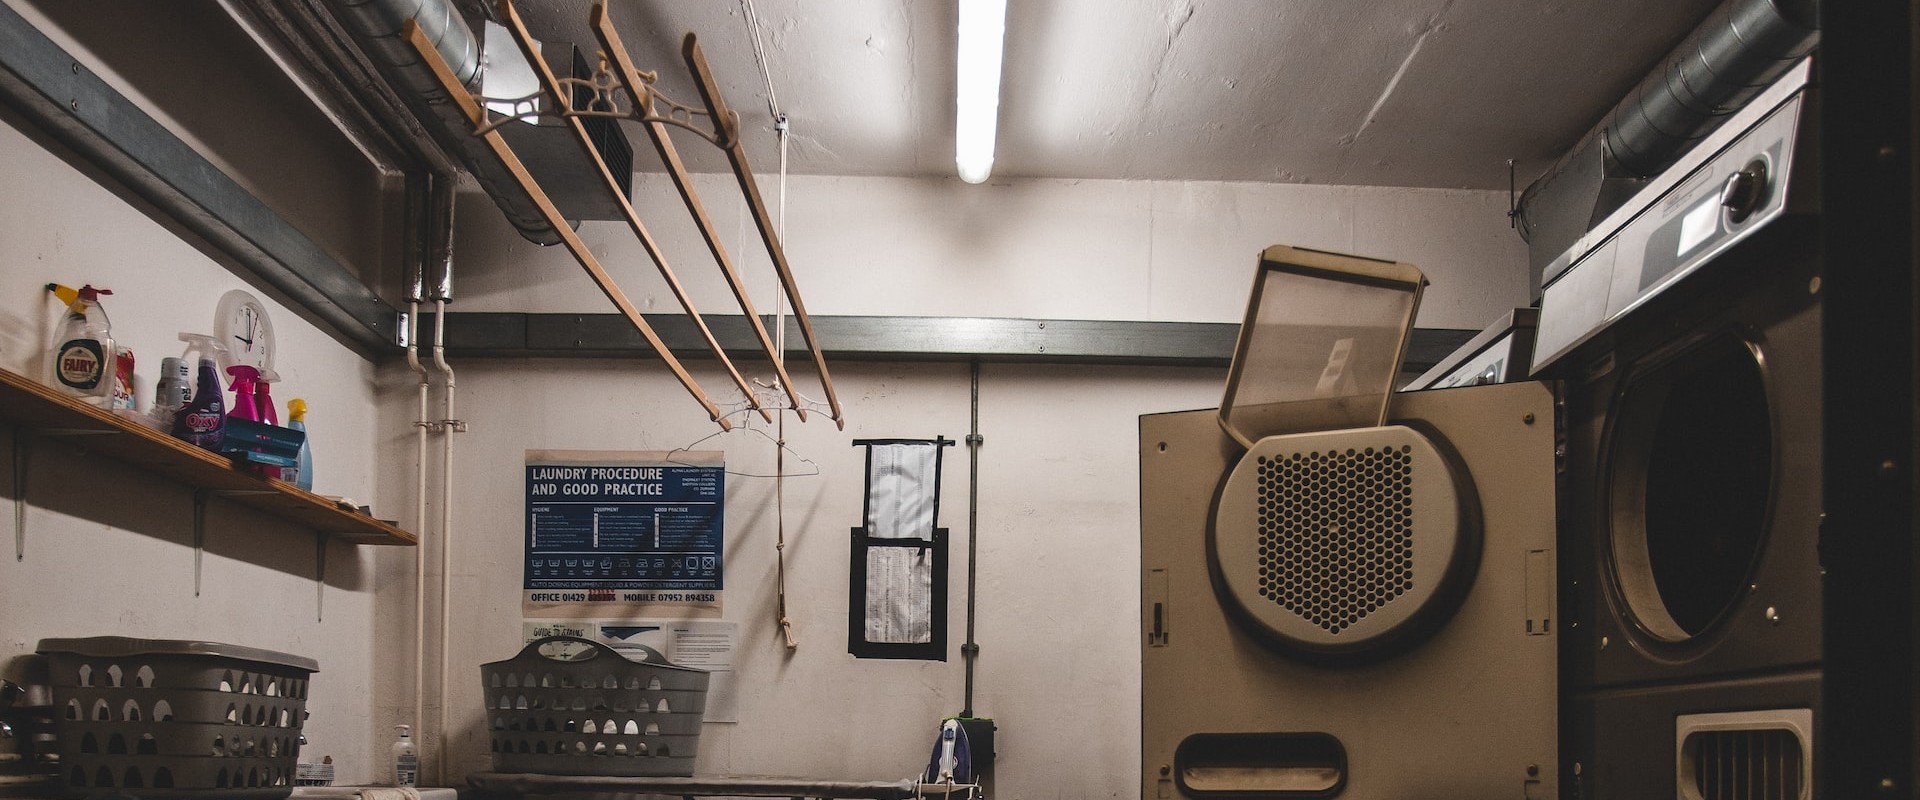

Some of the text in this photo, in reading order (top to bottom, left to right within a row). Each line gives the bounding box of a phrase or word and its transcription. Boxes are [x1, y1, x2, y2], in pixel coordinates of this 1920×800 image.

[64, 358, 96, 373] FAIRY
[185, 413, 220, 431] Oxy
[532, 468, 663, 480] LAUNDRY PROCEDURE
[532, 483, 663, 496] AND GOOD PRACTICE
[531, 593, 560, 601] OFFICE
[562, 593, 586, 601] 01429
[624, 593, 656, 602] MOBILE
[658, 593, 683, 602] 07952
[685, 593, 715, 602] 894358
[533, 627, 551, 636] GUIDE
[562, 628, 584, 637] STAINS
